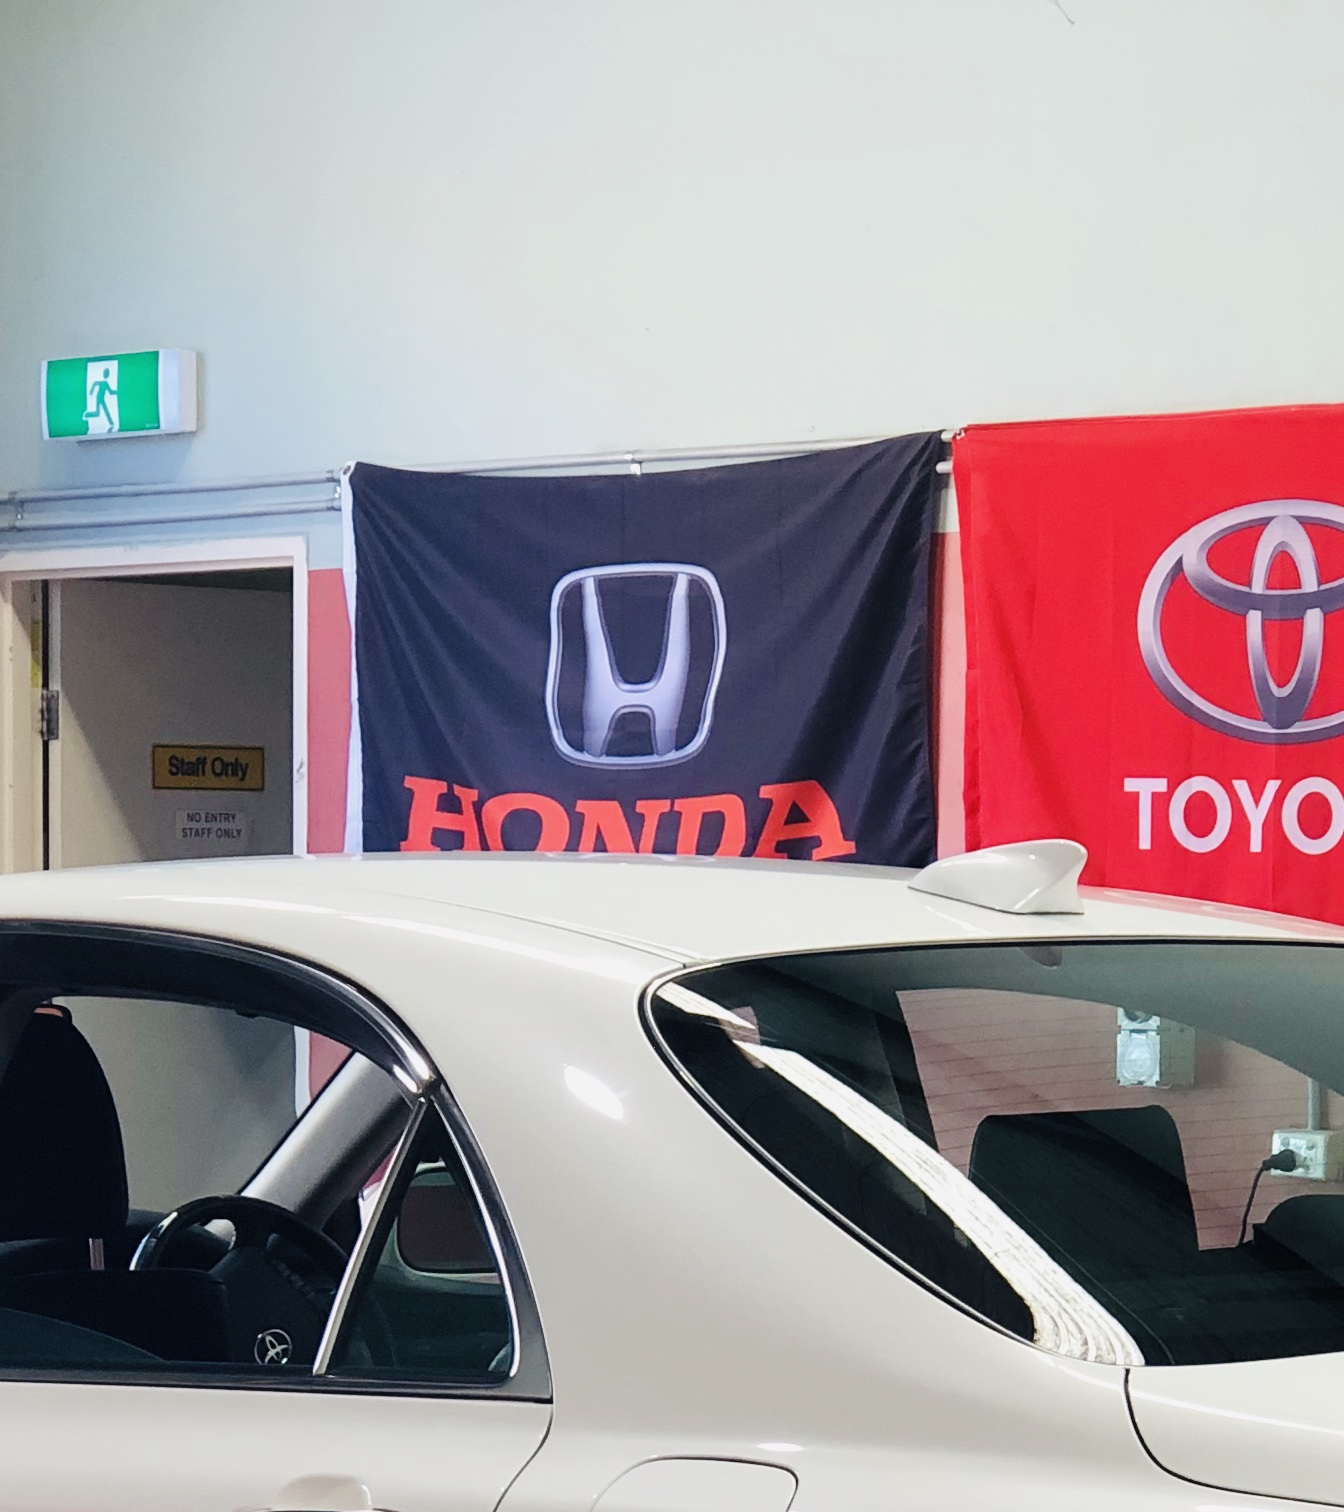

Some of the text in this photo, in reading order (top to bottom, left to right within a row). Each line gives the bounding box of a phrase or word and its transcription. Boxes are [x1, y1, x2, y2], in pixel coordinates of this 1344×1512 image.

[168, 755, 249, 782] Staff Only
[187, 812, 237, 824] NO ENTRY
[400, 775, 856, 862] HONDA
[181, 827, 242, 840] STAFF ONLY
